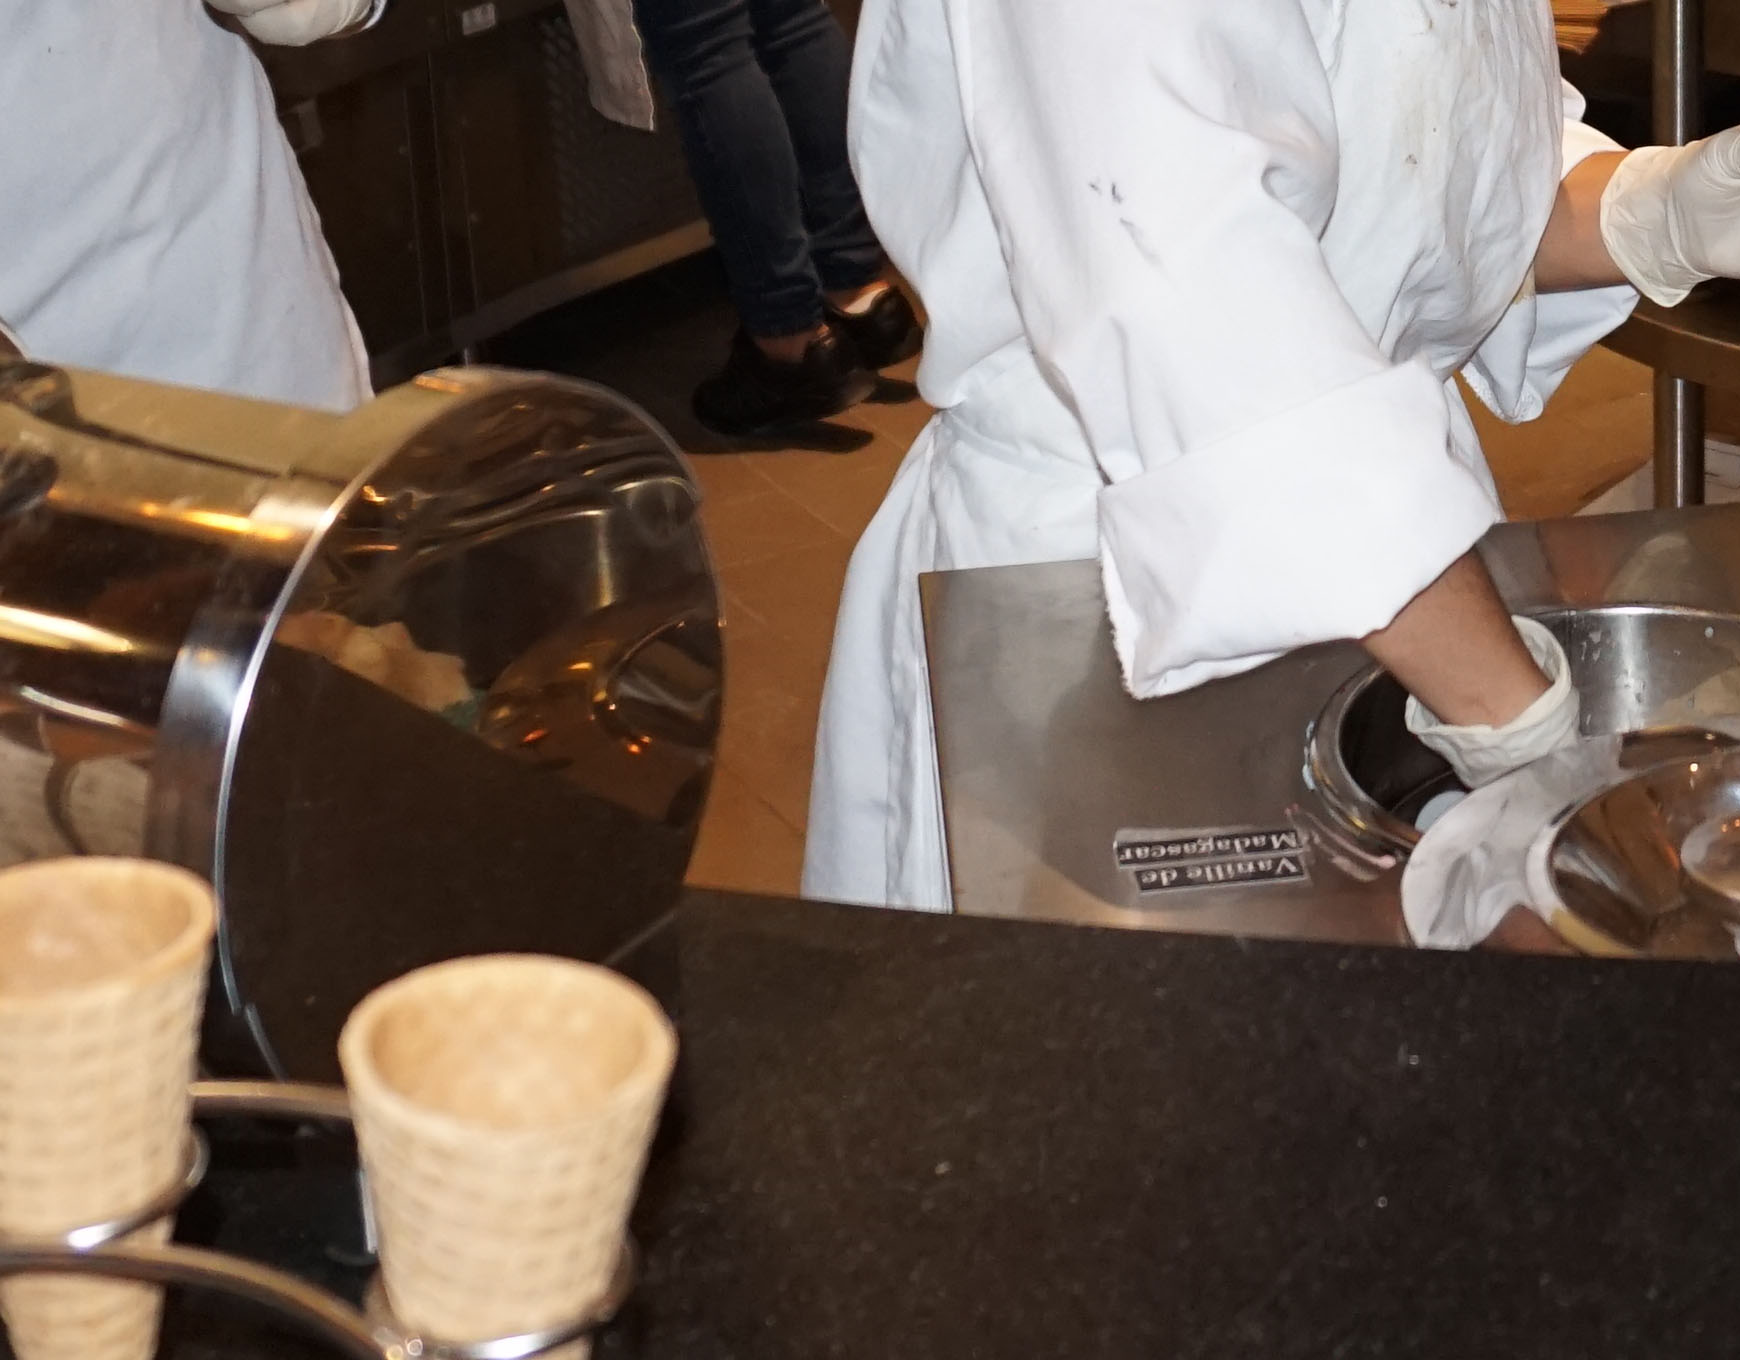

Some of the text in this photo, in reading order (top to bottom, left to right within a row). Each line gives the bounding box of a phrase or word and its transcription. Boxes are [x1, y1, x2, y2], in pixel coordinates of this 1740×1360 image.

[1118, 831, 1298, 862] Madagascar
[1140, 856, 1299, 887] Vanille de
